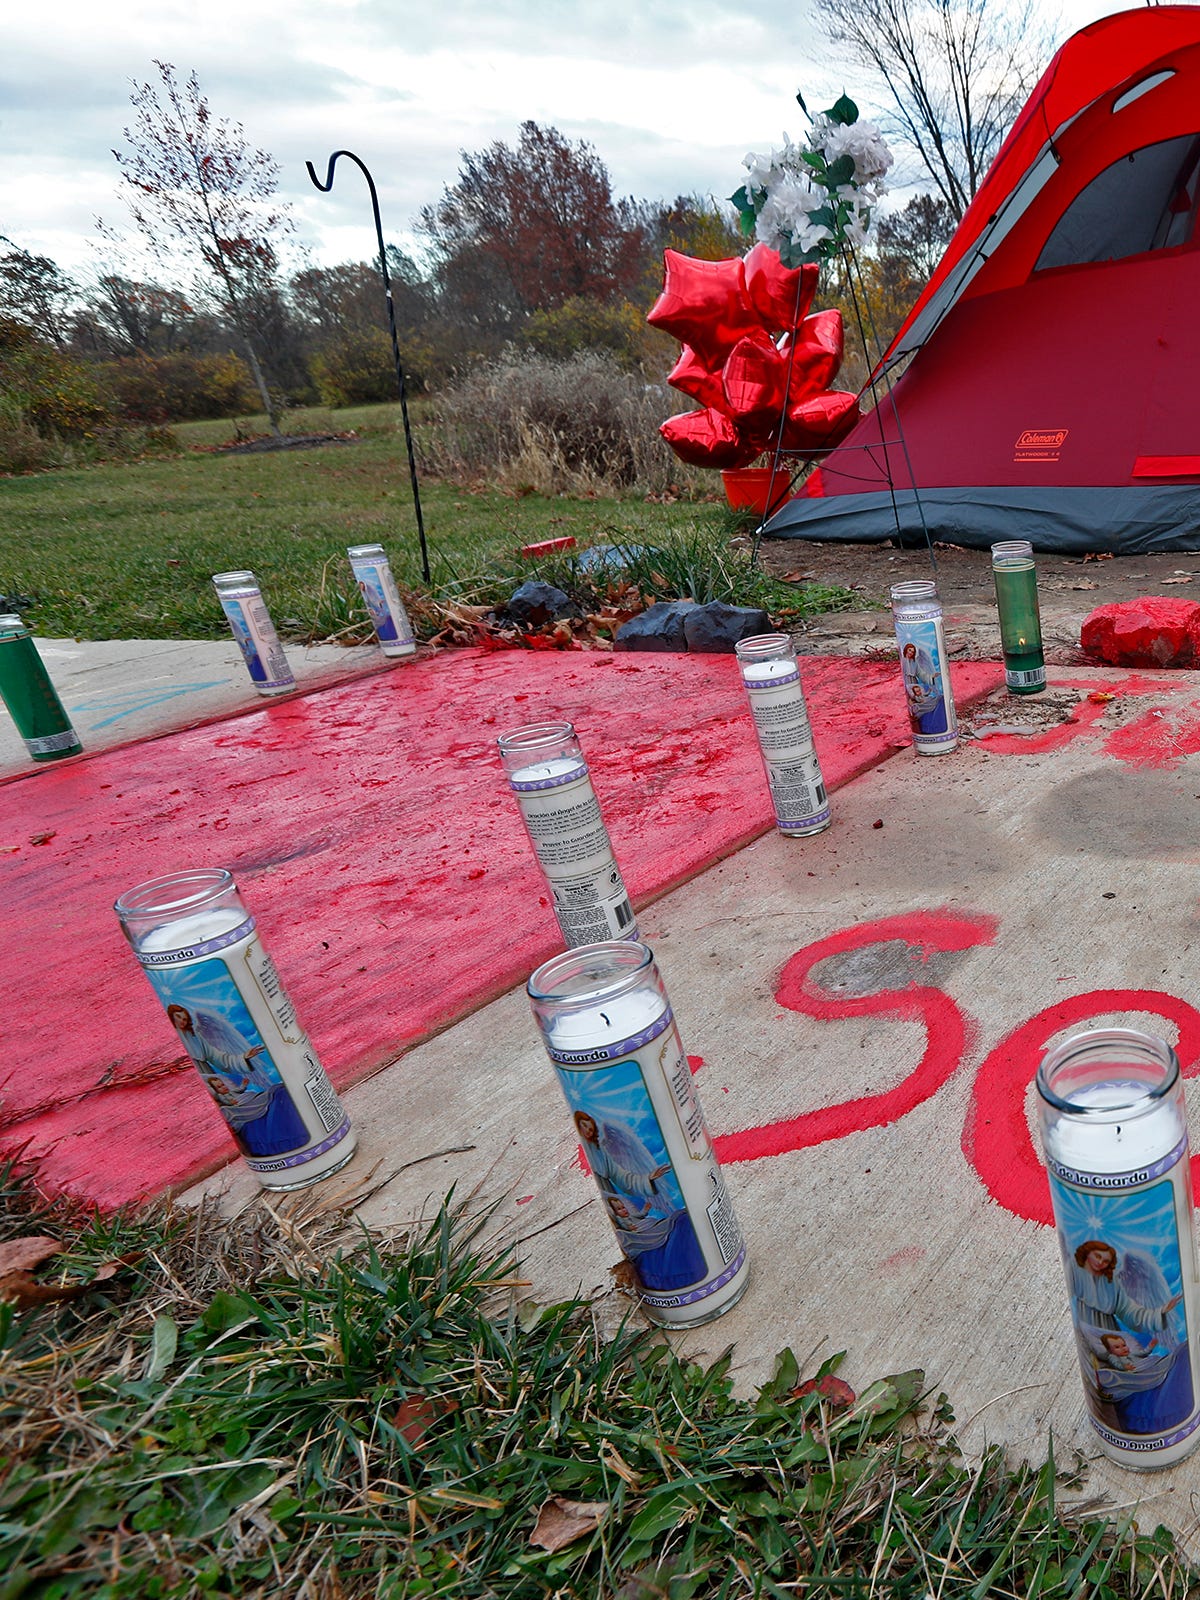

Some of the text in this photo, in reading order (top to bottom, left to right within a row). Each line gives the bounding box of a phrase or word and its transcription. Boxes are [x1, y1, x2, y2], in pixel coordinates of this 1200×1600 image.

[1021, 432, 1056, 444] Coleman
[150, 950, 194, 963] Guarda
[562, 1050, 609, 1062] Guarda
[1059, 1167, 1148, 1187] de la Guarda
